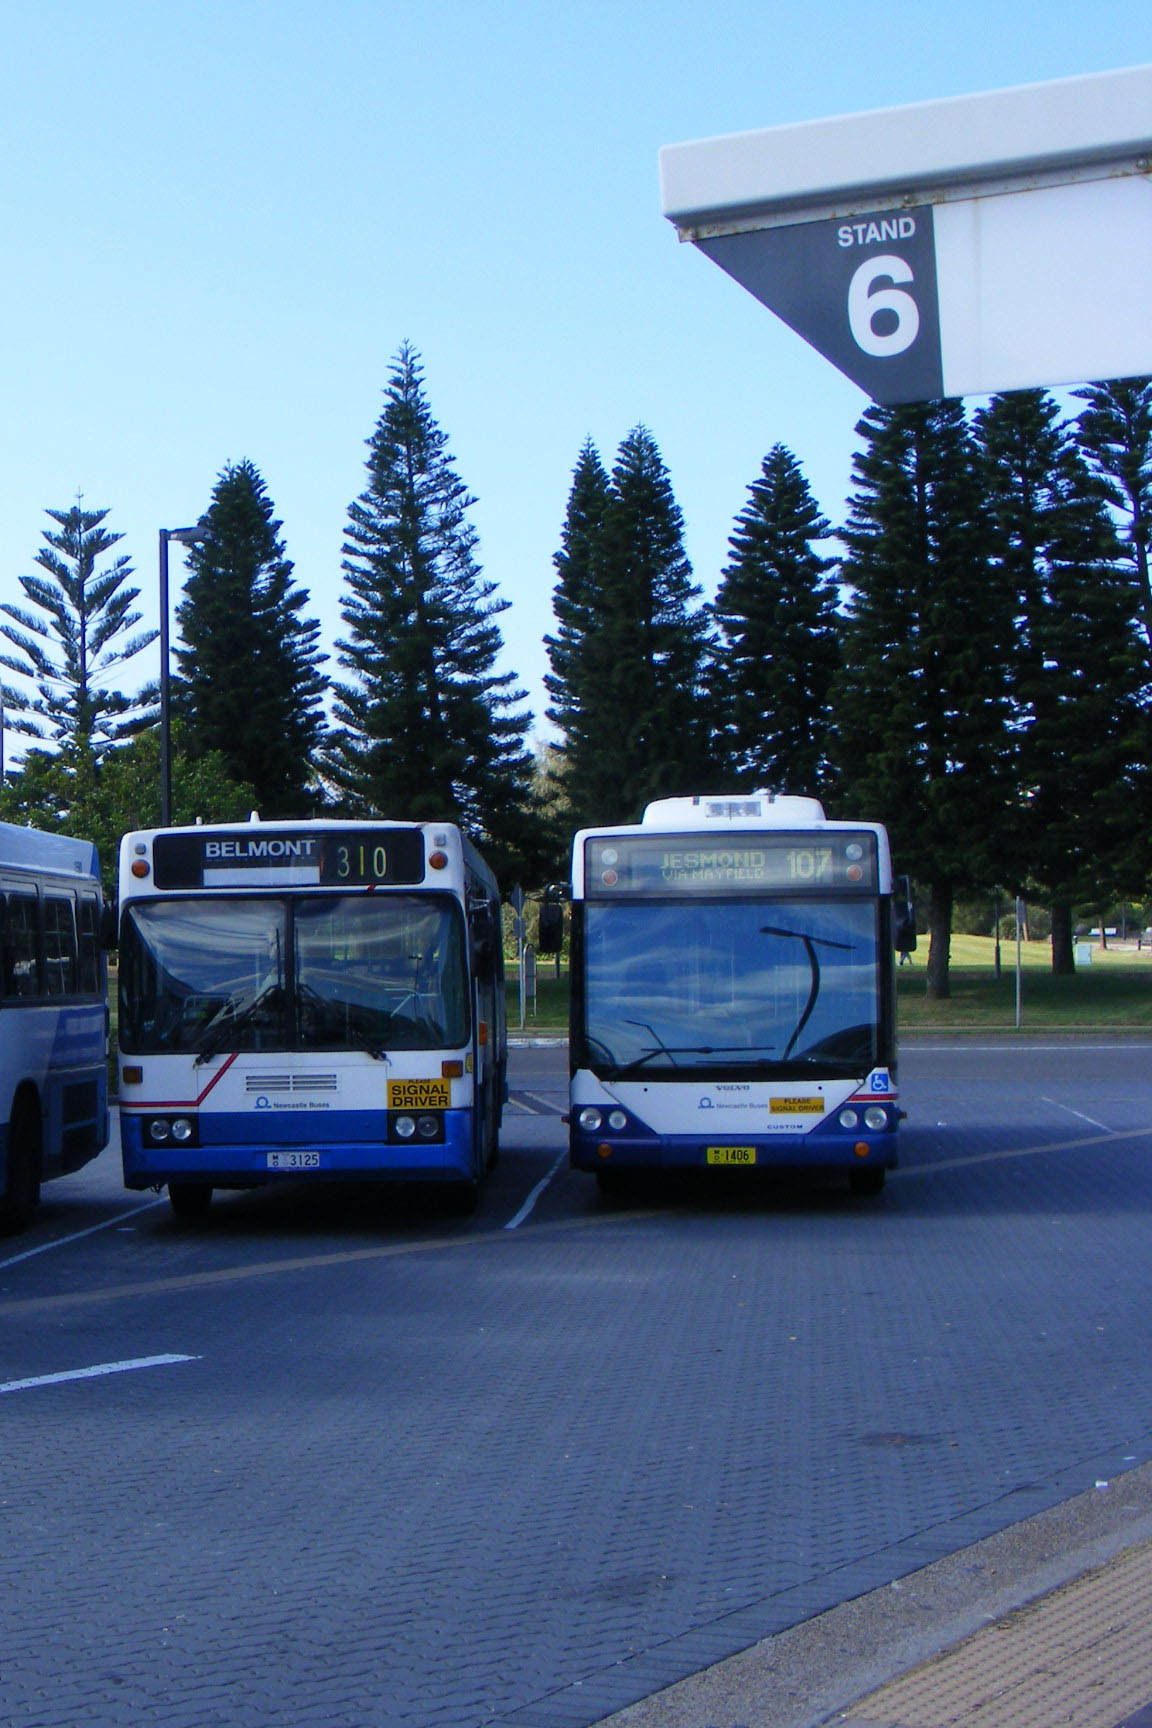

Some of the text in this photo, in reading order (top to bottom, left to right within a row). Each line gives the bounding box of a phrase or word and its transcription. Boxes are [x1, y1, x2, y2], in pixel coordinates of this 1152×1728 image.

[838, 216, 916, 247] STAND
[848, 254, 920, 358] 6
[205, 839, 387, 878] BELMONT 310
[660, 848, 832, 880] JESMOND 107
[661, 868, 765, 881] VIA MAYFIELD
[391, 1085, 448, 1096] SIGNAL
[273, 1101, 330, 1109] Newcastle Buses
[392, 1096, 448, 1107] DRIVER
[770, 1104, 796, 1112] SIGNAL
[290, 1154, 319, 1166] 3125
[725, 1150, 750, 1161] 1406
